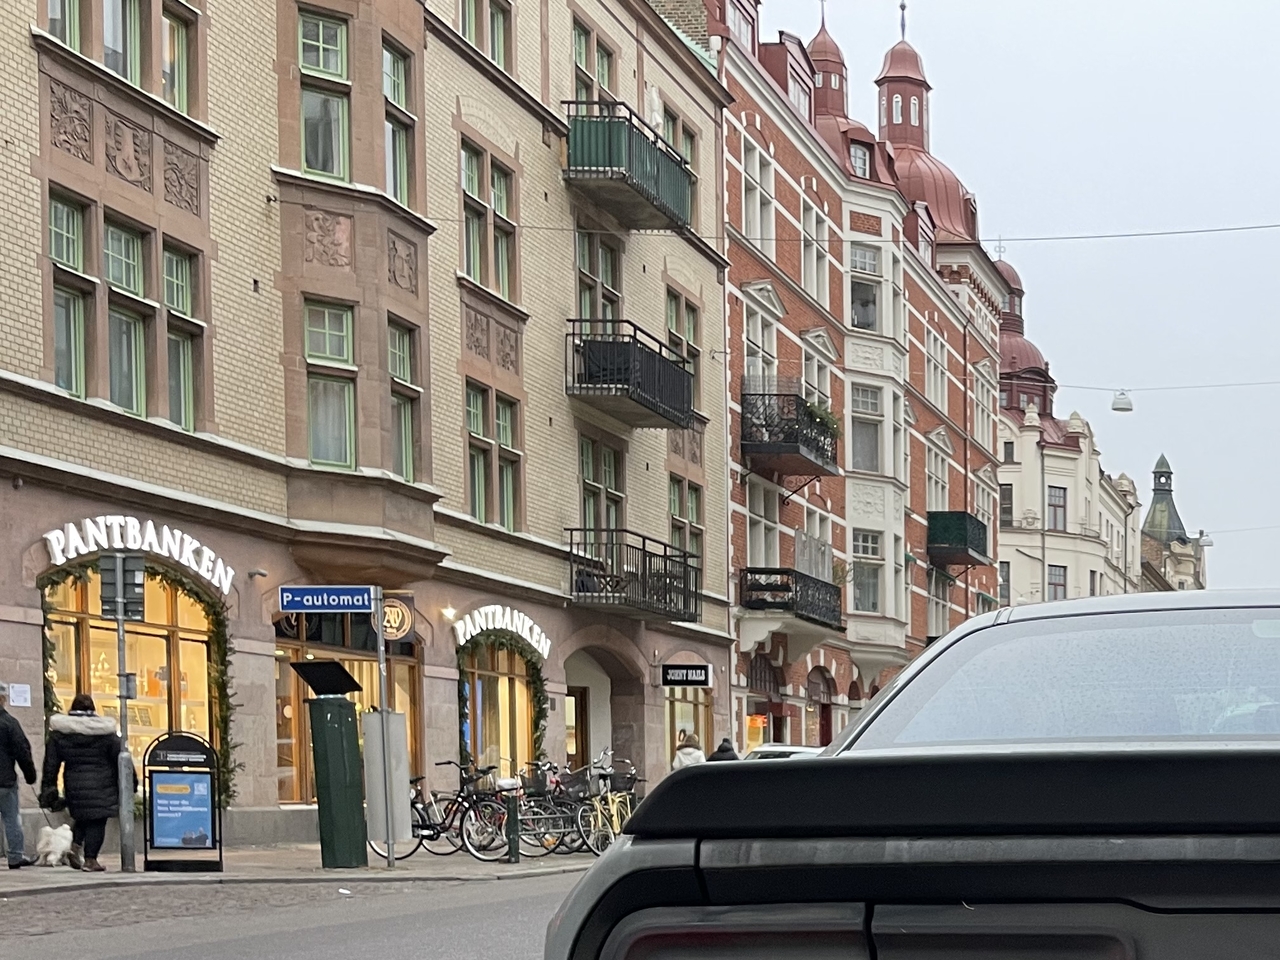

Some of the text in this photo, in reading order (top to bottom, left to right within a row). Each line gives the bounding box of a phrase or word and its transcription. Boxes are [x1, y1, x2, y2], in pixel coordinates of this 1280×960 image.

[43, 515, 235, 595] PANTBANKEN
[283, 592, 369, 606] P-automat
[453, 605, 551, 659] PANTBANKEN
